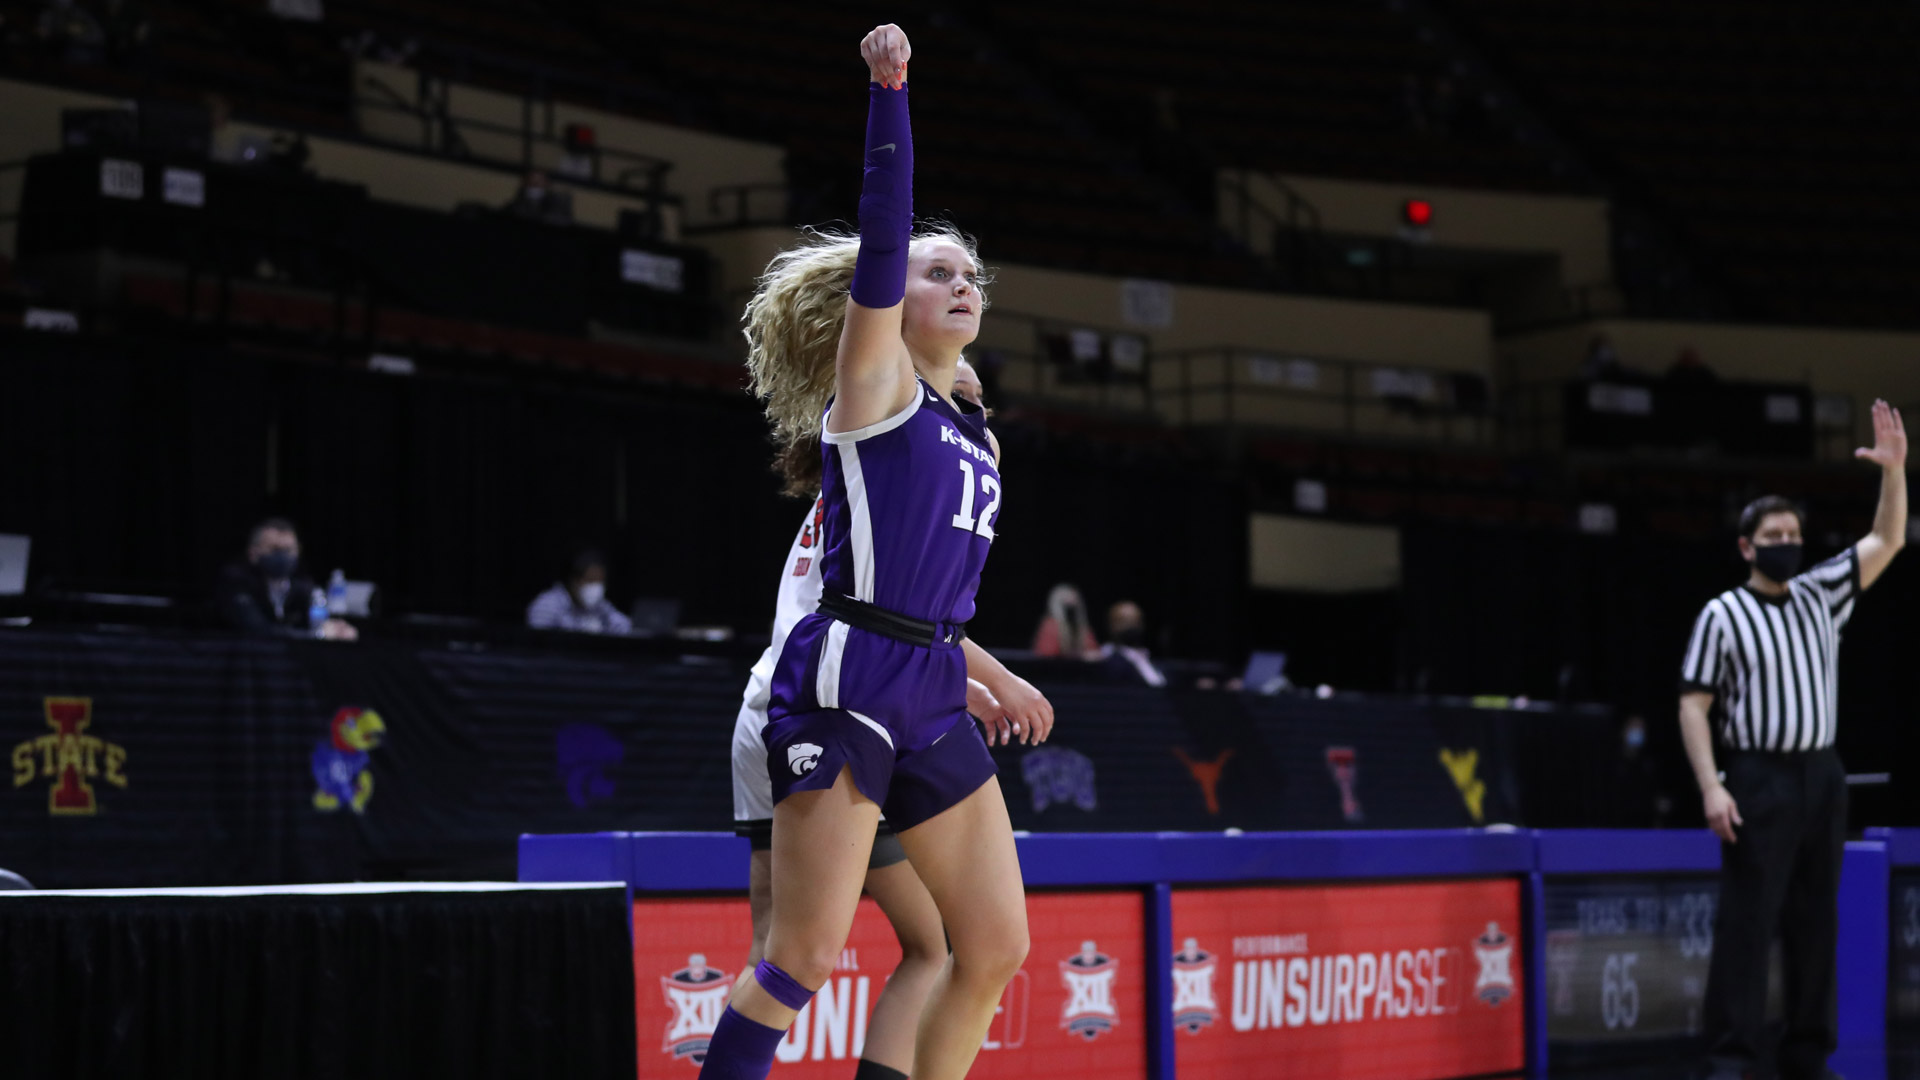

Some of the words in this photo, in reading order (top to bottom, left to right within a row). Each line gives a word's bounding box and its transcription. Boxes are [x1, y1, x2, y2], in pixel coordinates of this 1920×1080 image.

[952, 458, 1001, 544] 12
[11, 733, 128, 788] STATE
[1602, 953, 1639, 1029] 65
